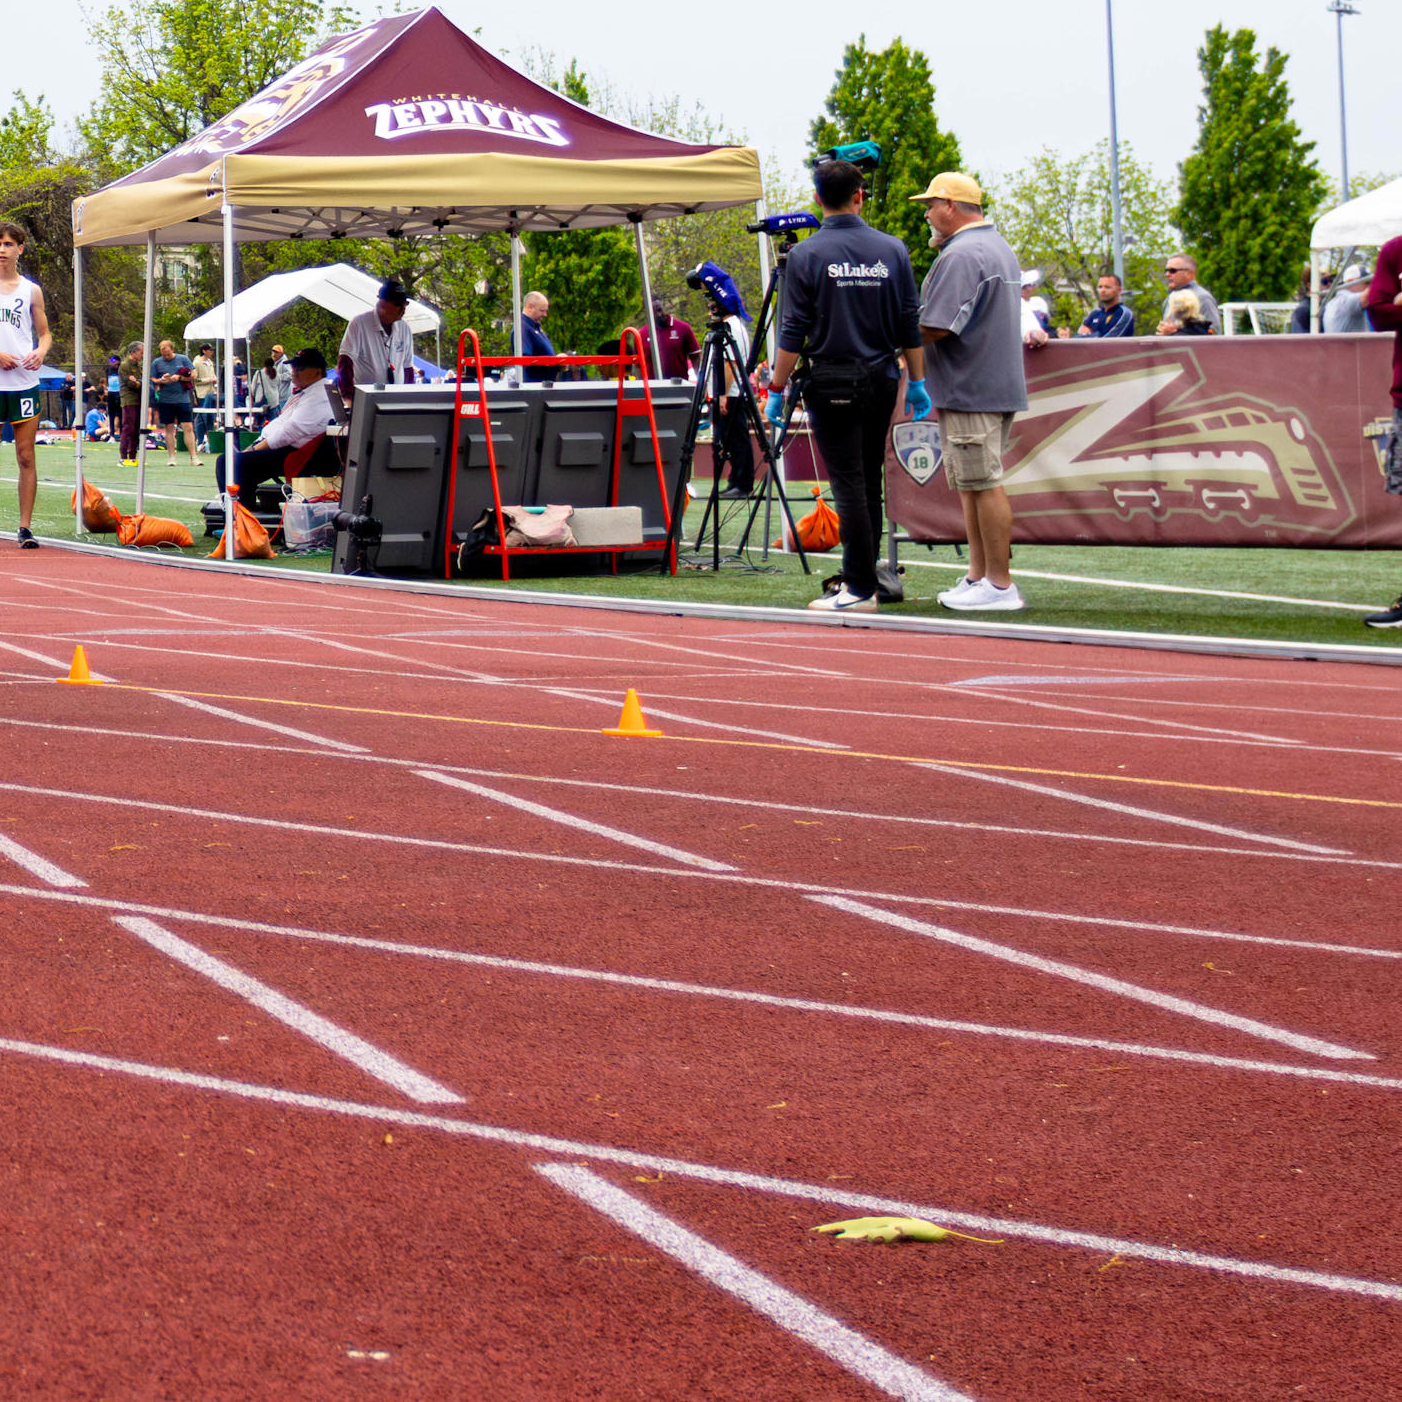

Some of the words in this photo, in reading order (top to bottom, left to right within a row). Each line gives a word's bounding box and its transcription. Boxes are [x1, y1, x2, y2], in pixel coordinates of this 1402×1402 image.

[392, 93, 523, 114] WHITEHALL
[364, 99, 570, 147] ZEPHYRS
[836, 279, 855, 288] Sports
[12, 298, 24, 315] 2
[22, 399, 33, 416] 2
[460, 403, 481, 415] GILL
[912, 456, 929, 469] 18
